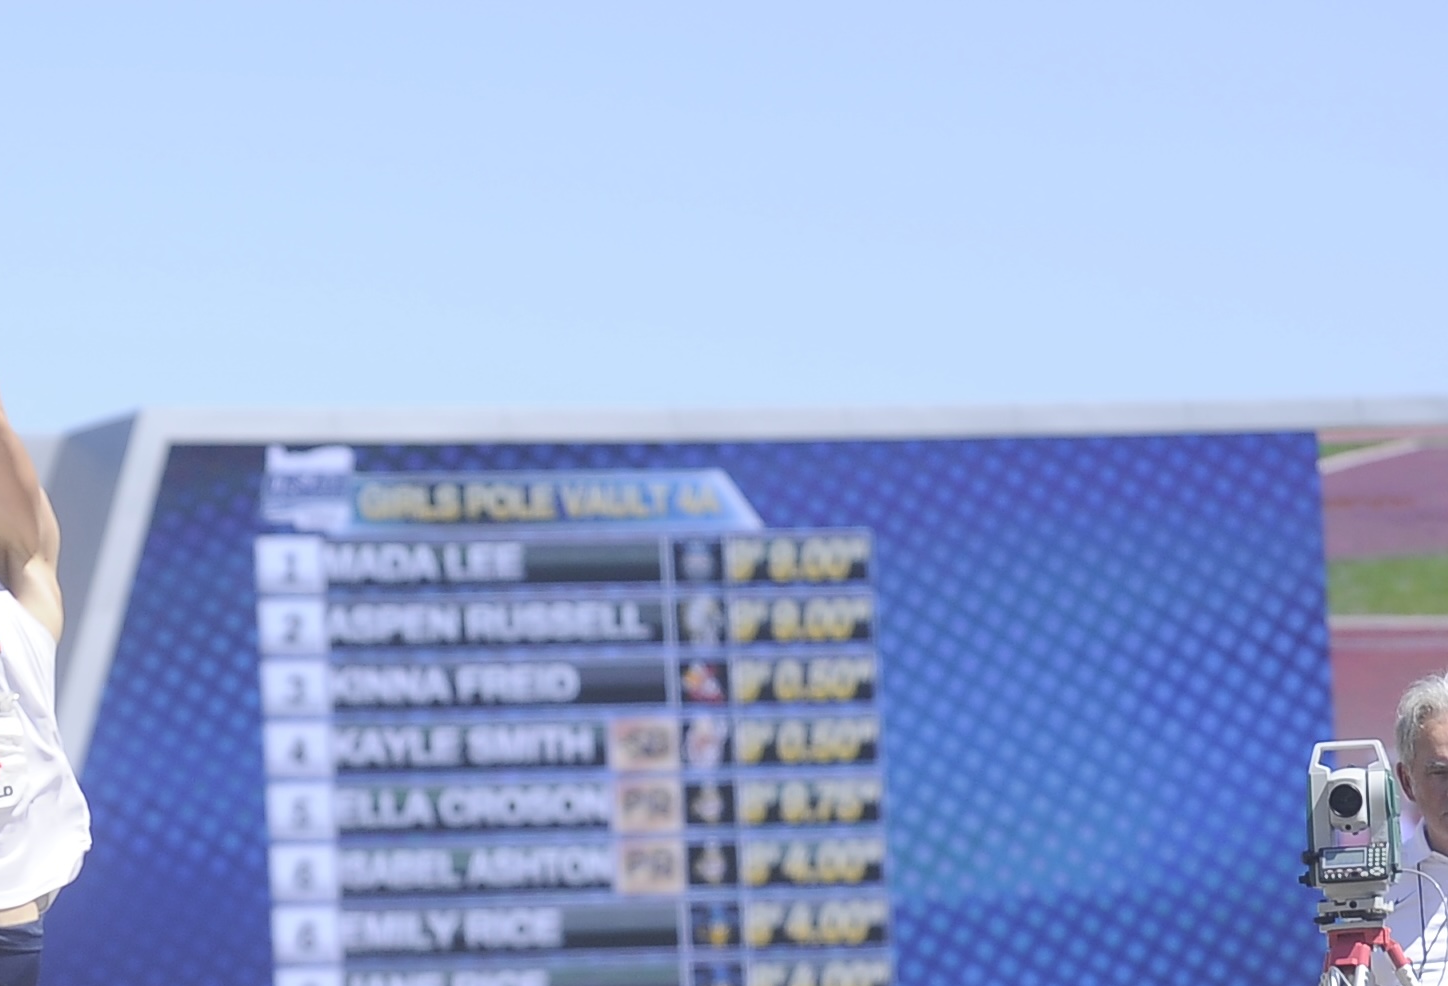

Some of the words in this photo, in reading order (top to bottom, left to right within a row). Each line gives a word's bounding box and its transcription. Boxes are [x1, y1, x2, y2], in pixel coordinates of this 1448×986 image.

[358, 485, 459, 520] GIRLS
[468, 484, 557, 520] POLE
[562, 482, 668, 518] VAULT
[447, 543, 525, 579] LEE
[328, 604, 456, 641] ASPEN
[465, 602, 649, 641] RUSSELL
[333, 727, 459, 766] KAYLE
[466, 724, 596, 764] SMITH
[342, 911, 461, 949] EMILY
[464, 908, 563, 947] RICE
